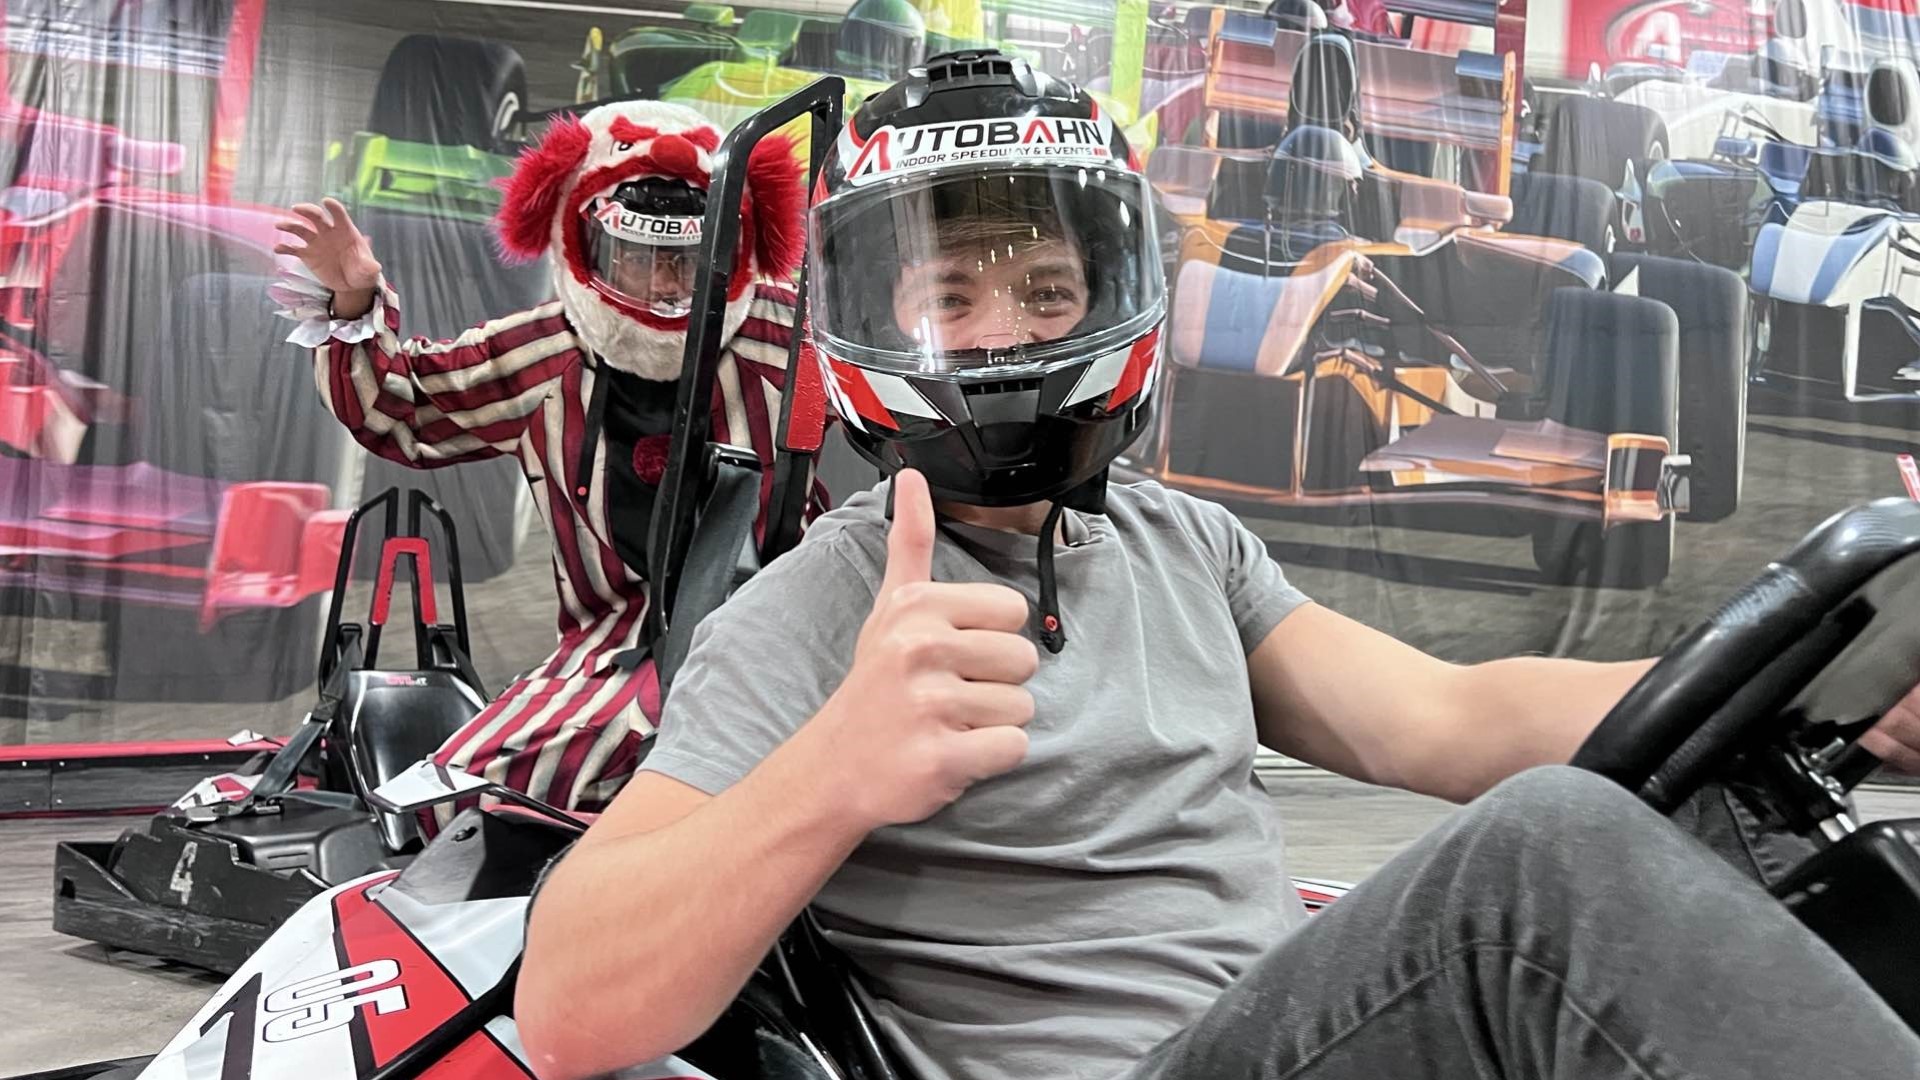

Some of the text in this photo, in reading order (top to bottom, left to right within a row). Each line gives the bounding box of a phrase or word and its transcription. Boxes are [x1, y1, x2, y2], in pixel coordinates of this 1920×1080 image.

[847, 119, 1105, 180] AUTOBAHN
[896, 154, 946, 168] INDOOR
[1034, 147, 1042, 155] &
[1045, 146, 1093, 156] EVENTS
[594, 202, 702, 235] AUTOBA
